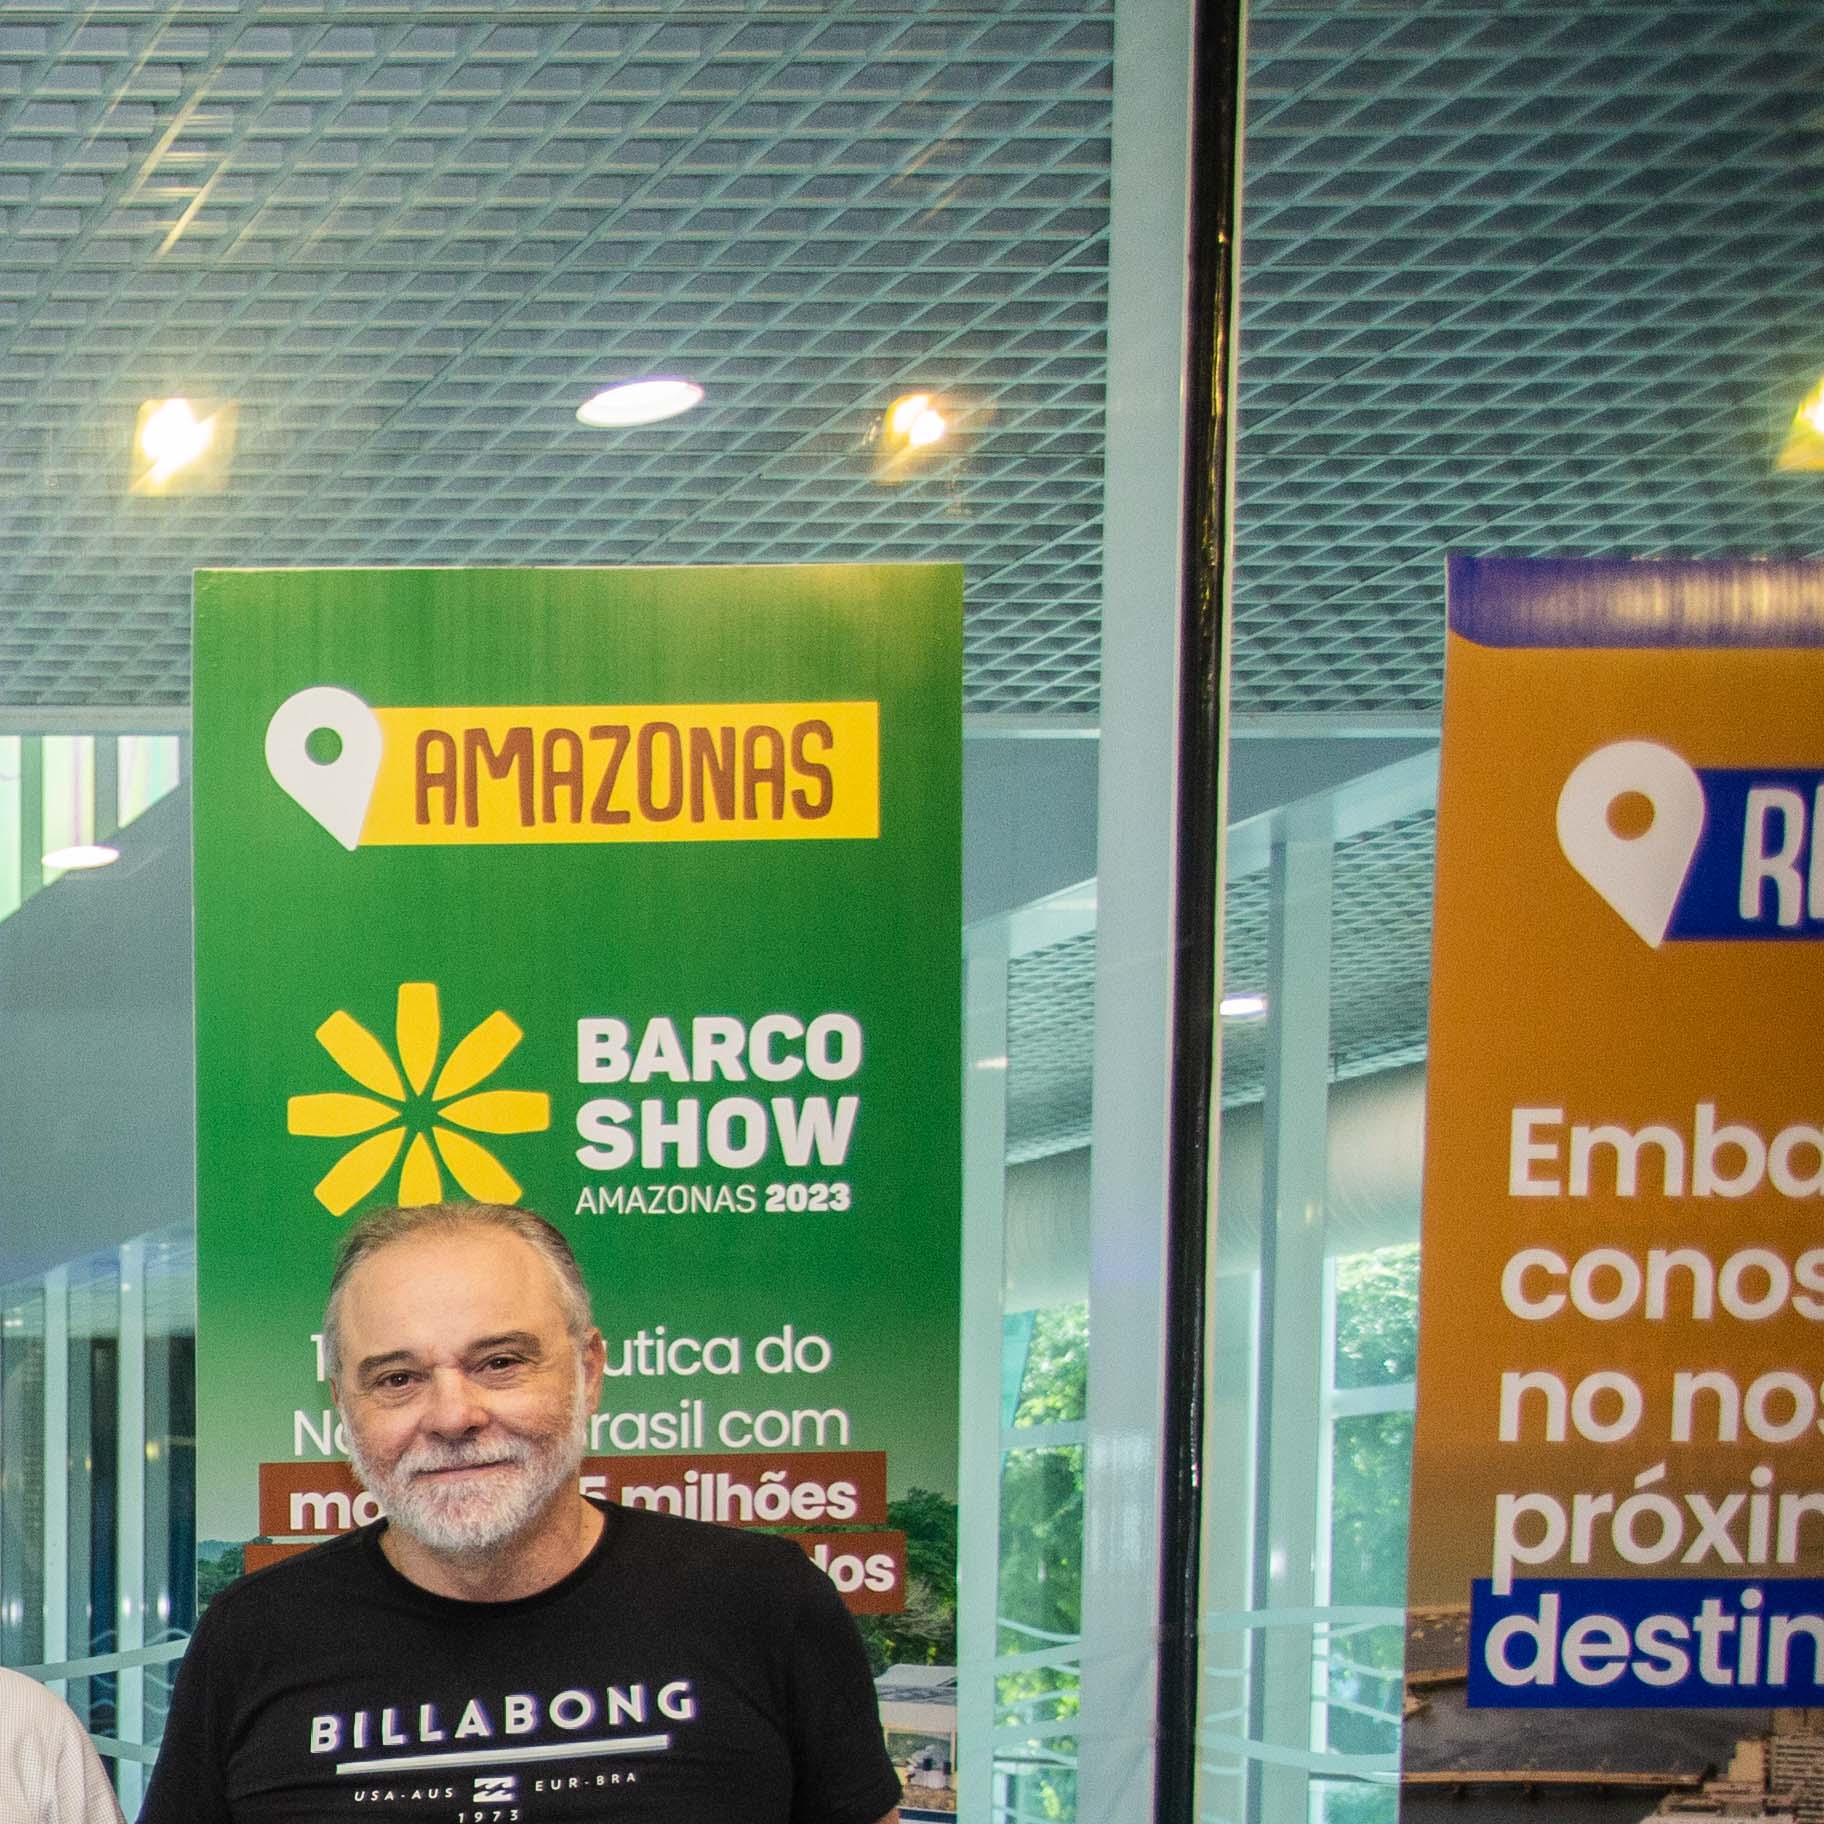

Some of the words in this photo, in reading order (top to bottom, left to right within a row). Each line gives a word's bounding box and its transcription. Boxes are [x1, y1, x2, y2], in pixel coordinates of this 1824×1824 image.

[414, 718, 836, 829] AMAZONAS
[1739, 784, 1824, 927] R
[576, 1012, 864, 1085] BARCO
[575, 1096, 860, 1171] SHOW
[574, 1184, 758, 1216] AMAZONAS
[764, 1182, 852, 1214] 2023
[601, 1324, 741, 1378] utica
[755, 1323, 832, 1375] do
[586, 1398, 705, 1452] rasil
[717, 1406, 851, 1449] com
[1498, 1368, 1645, 1444] no
[1670, 1368, 1824, 1444] no
[620, 1468, 859, 1523] milhões
[309, 1680, 697, 1755] BILLABONG
[353, 1786, 455, 1803] USA-AUS
[534, 1772, 638, 1793] EUR-BRA
[457, 1809, 520, 1824] 1973
